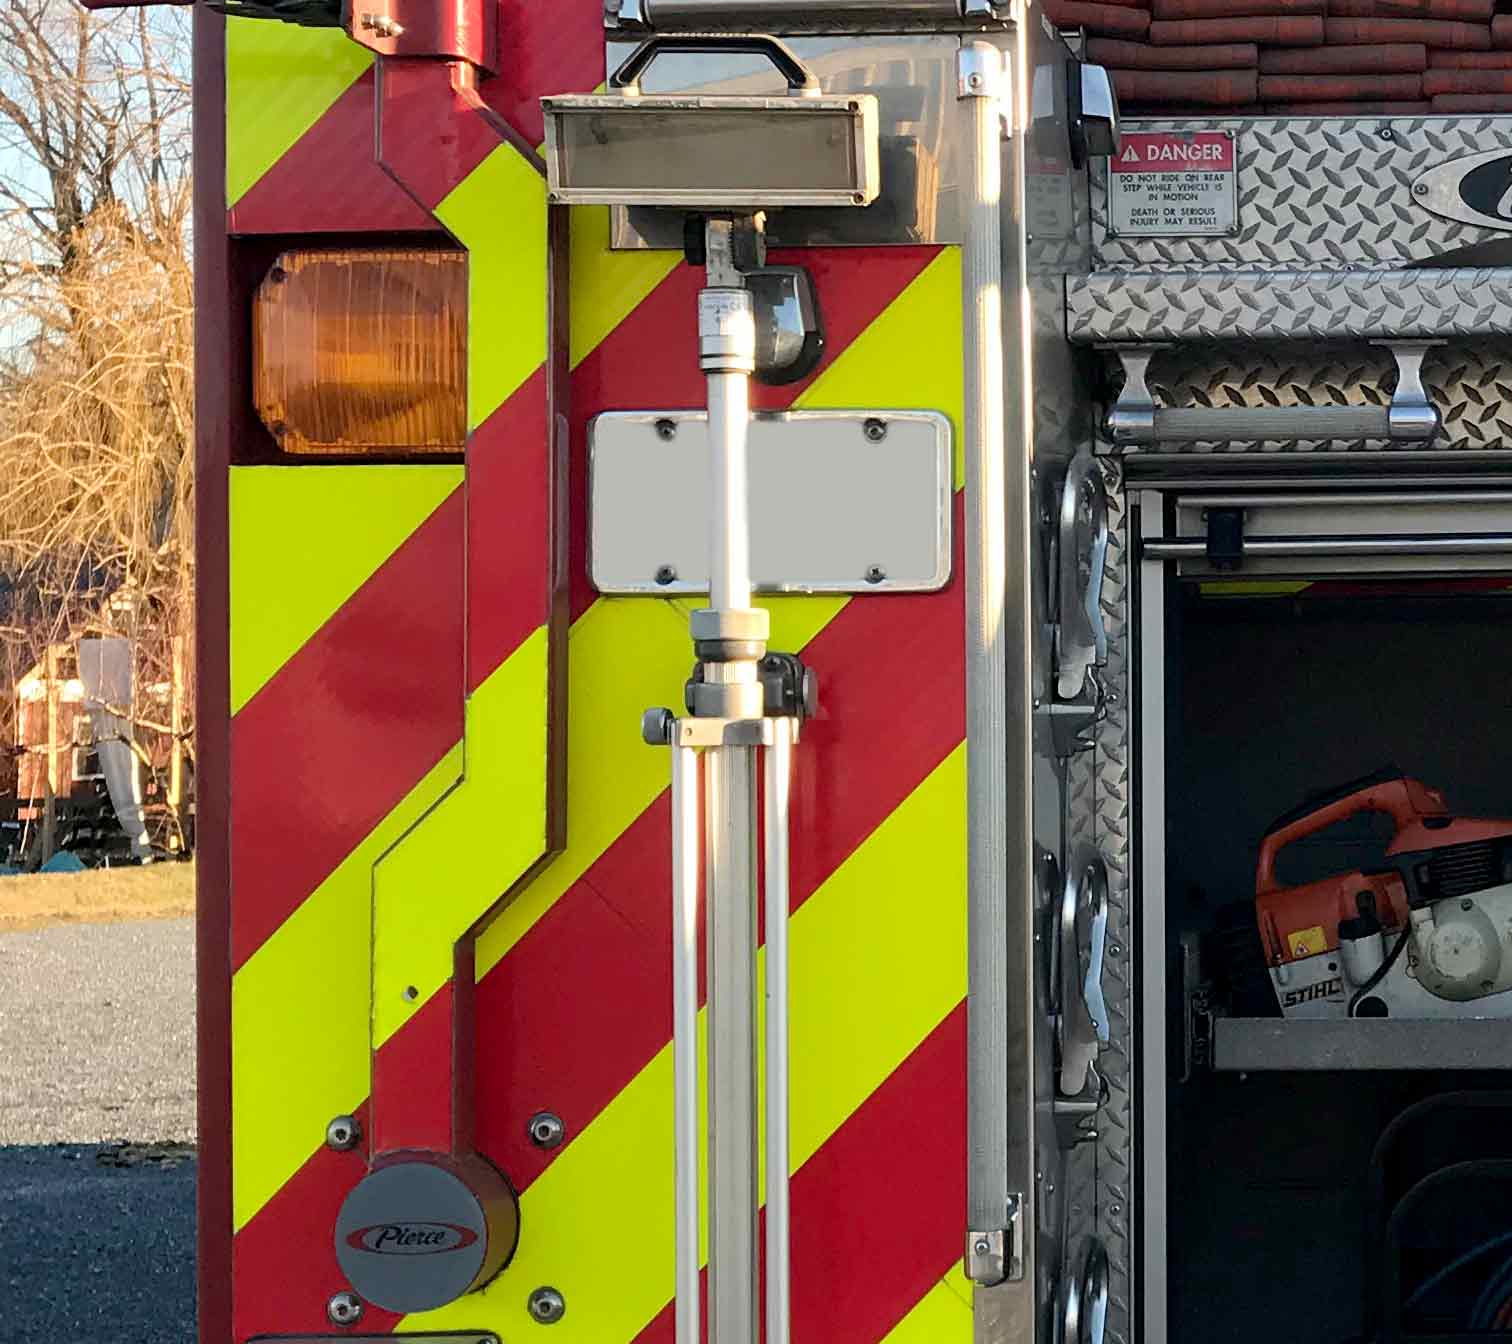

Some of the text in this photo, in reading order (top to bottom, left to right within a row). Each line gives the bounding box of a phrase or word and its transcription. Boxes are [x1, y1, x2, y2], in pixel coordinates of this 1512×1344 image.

[1146, 144, 1223, 161] DANGER
[1120, 174, 1225, 183] DO NOT RIDE ON REAR
[1122, 184, 1142, 193] STEP
[1146, 184, 1172, 192] WHILE
[1177, 184, 1209, 192] VEHICLE
[1148, 193, 1198, 201] IN MOTION
[1131, 208, 1216, 217] DEATH OR SERIOUS
[1130, 217, 1217, 226] INJURY MAY RESULT
[1283, 982, 1341, 1008] STIHL
[375, 1225, 446, 1249] Pierce
